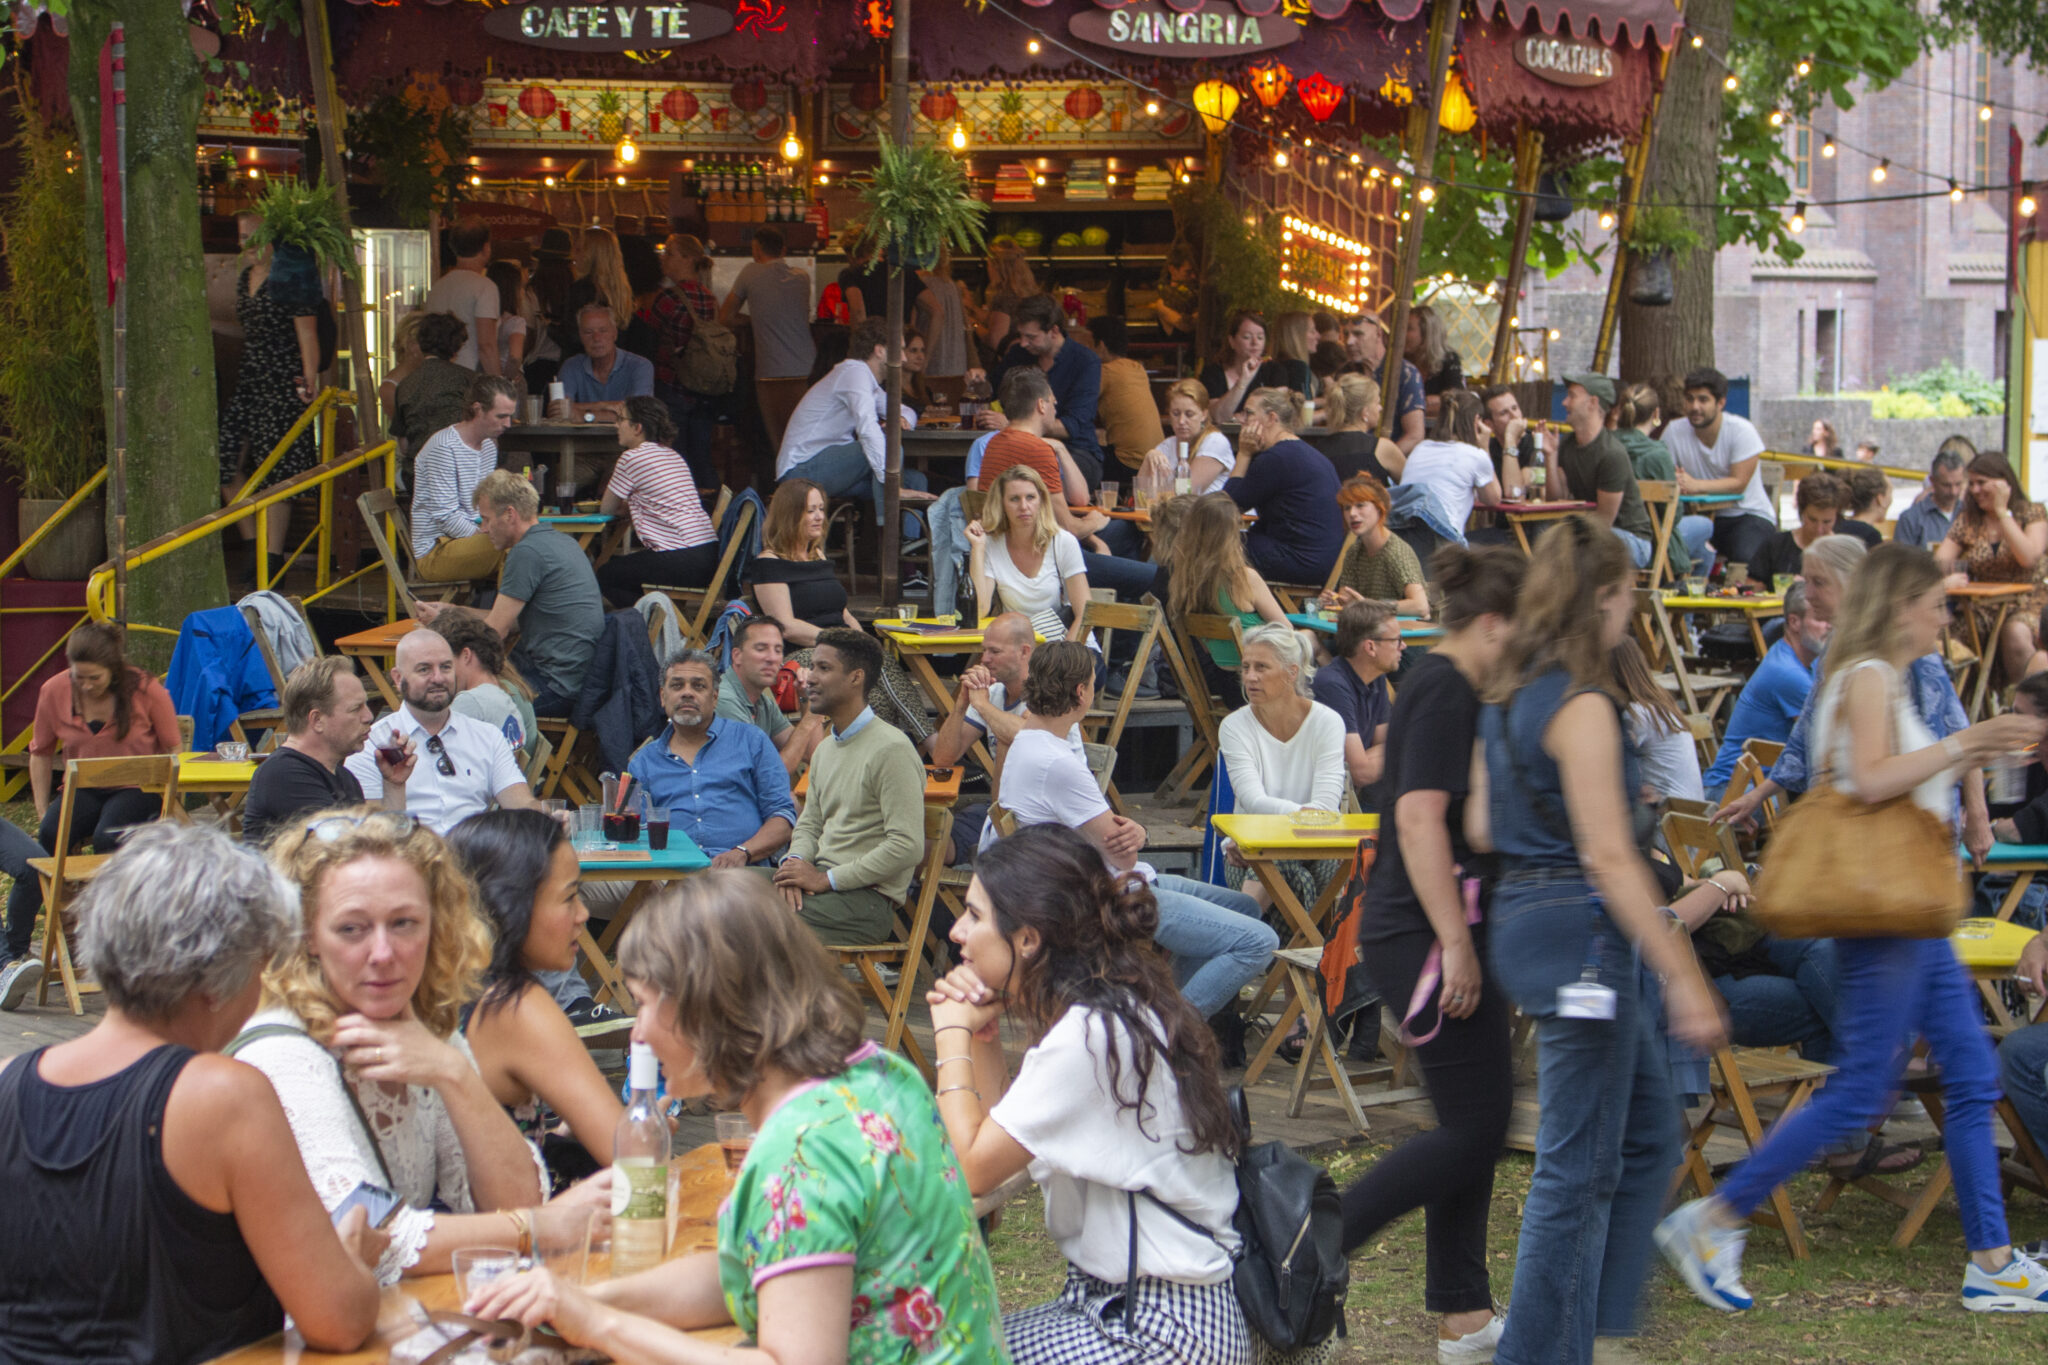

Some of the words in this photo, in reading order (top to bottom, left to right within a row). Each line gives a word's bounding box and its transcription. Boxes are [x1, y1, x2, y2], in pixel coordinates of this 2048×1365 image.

[520, 6, 610, 39] CAFE
[613, 6, 638, 39] Y
[1107, 9, 1263, 46] SANGRIA
[1525, 38, 1613, 78] COCKTAILS
